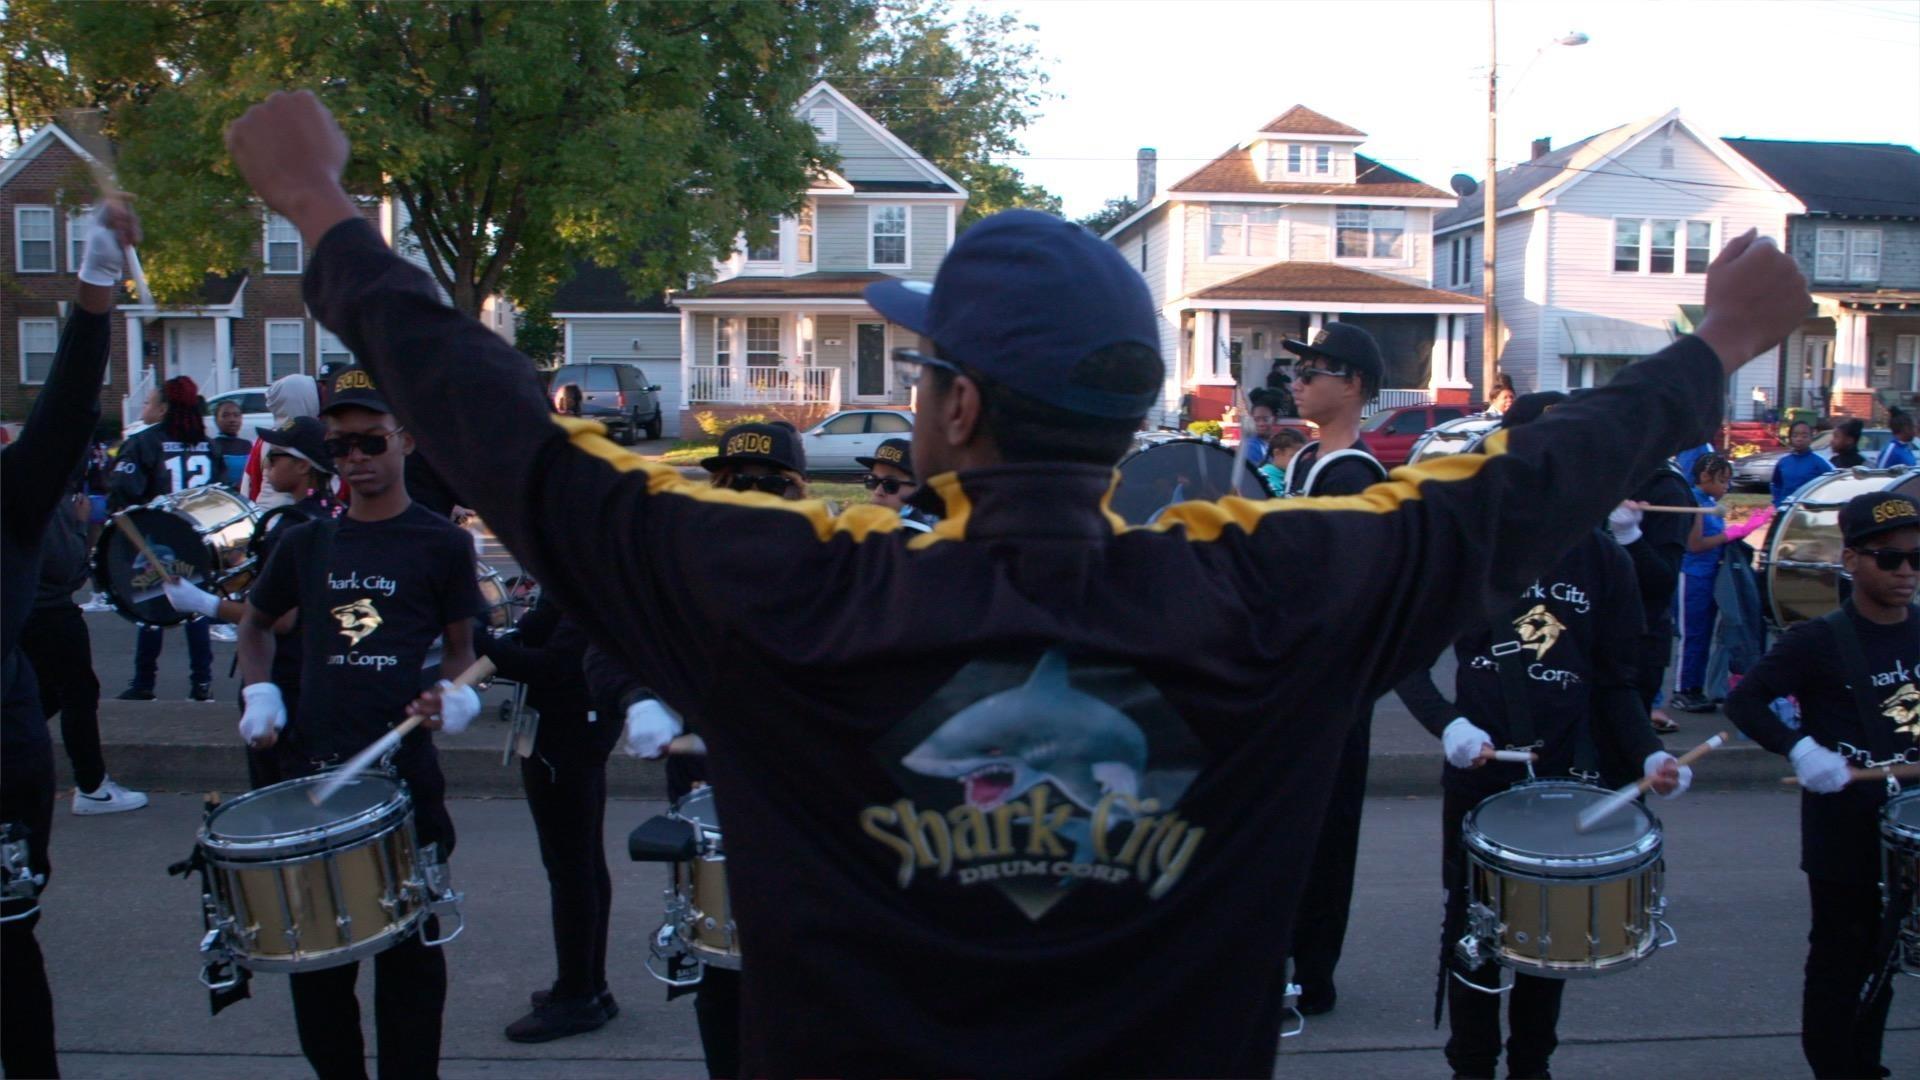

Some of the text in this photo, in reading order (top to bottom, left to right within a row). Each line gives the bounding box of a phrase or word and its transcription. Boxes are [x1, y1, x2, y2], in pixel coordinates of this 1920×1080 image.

[164, 454, 211, 495] 12
[327, 571, 396, 597] hark City
[1551, 582, 1590, 613] City
[347, 651, 397, 671] Corps
[860, 785, 1206, 899] Shark City
[958, 859, 1131, 886] DRUM CORP
